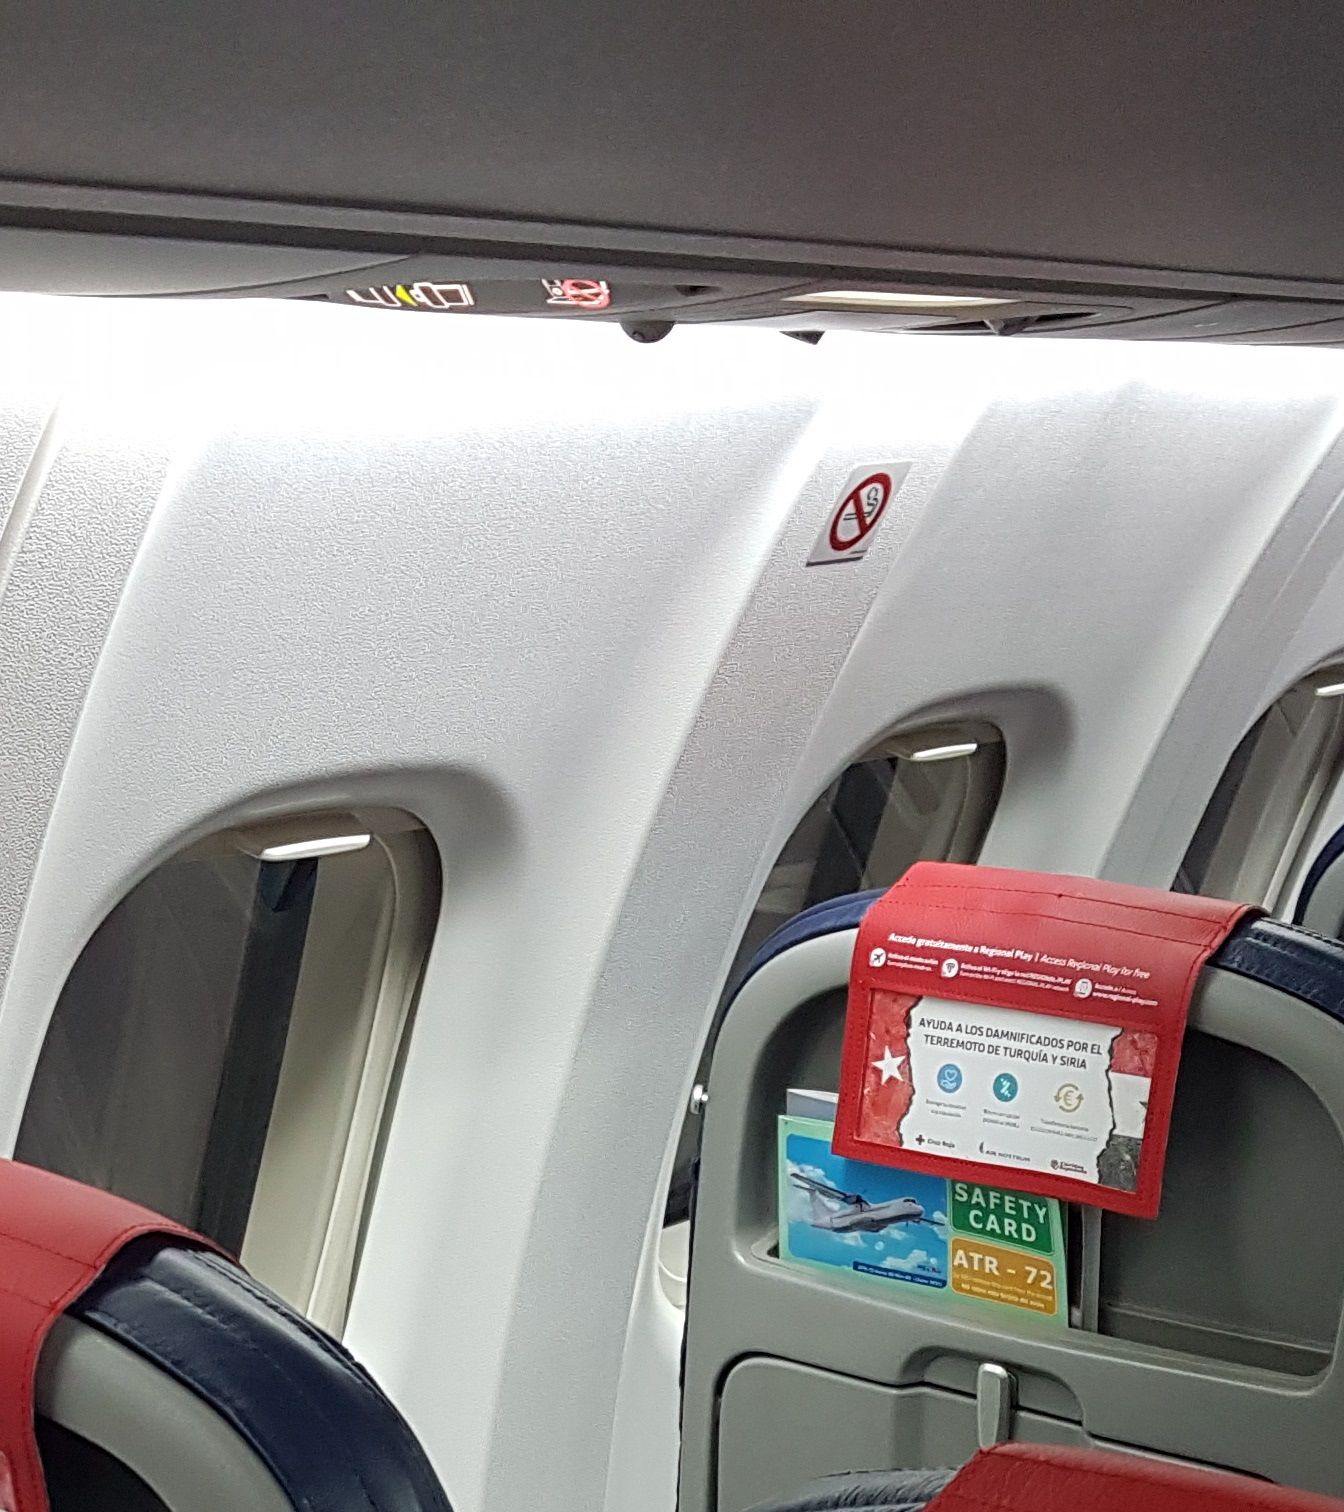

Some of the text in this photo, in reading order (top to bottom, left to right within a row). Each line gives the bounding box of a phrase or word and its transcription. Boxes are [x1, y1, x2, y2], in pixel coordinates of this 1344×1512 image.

[1014, 949, 1033, 962] Play
[919, 1017, 1103, 1055] AYUDA A LOS DAMNIFICADOS POR EL
[922, 1034, 1087, 1069] TERREMOTO DE TURQUÍA Y SIRIA
[954, 1182, 1047, 1224] SAFETY
[968, 1209, 1036, 1242] CARD
[953, 1249, 1000, 1276] ATR
[1024, 1266, 1053, 1290] 72
